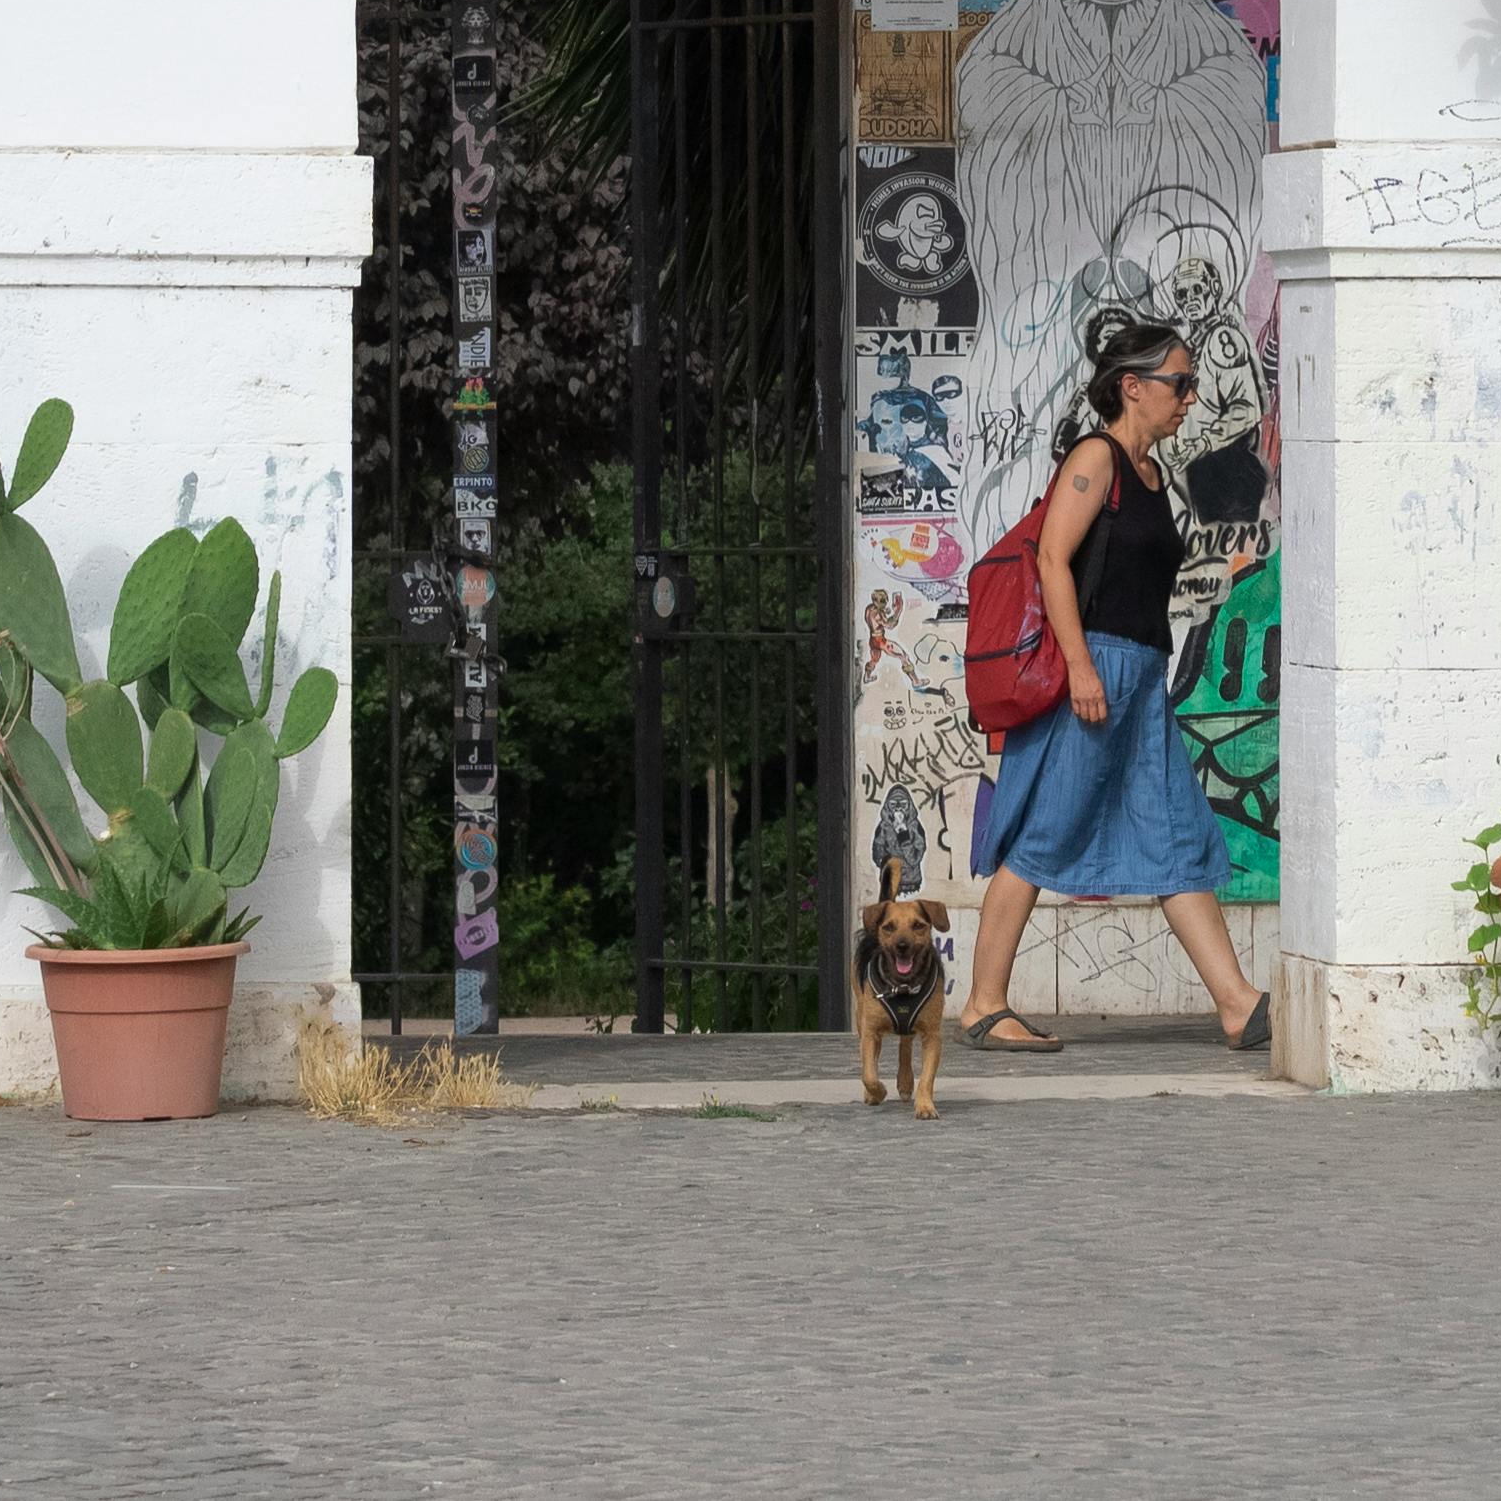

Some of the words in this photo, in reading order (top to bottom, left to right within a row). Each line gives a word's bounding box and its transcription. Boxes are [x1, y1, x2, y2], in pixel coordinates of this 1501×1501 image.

[858, 118, 939, 138] BUDDHA
[891, 177, 926, 192] INVASION
[856, 331, 975, 356] SMILE
[1218, 330, 1237, 359] 8
